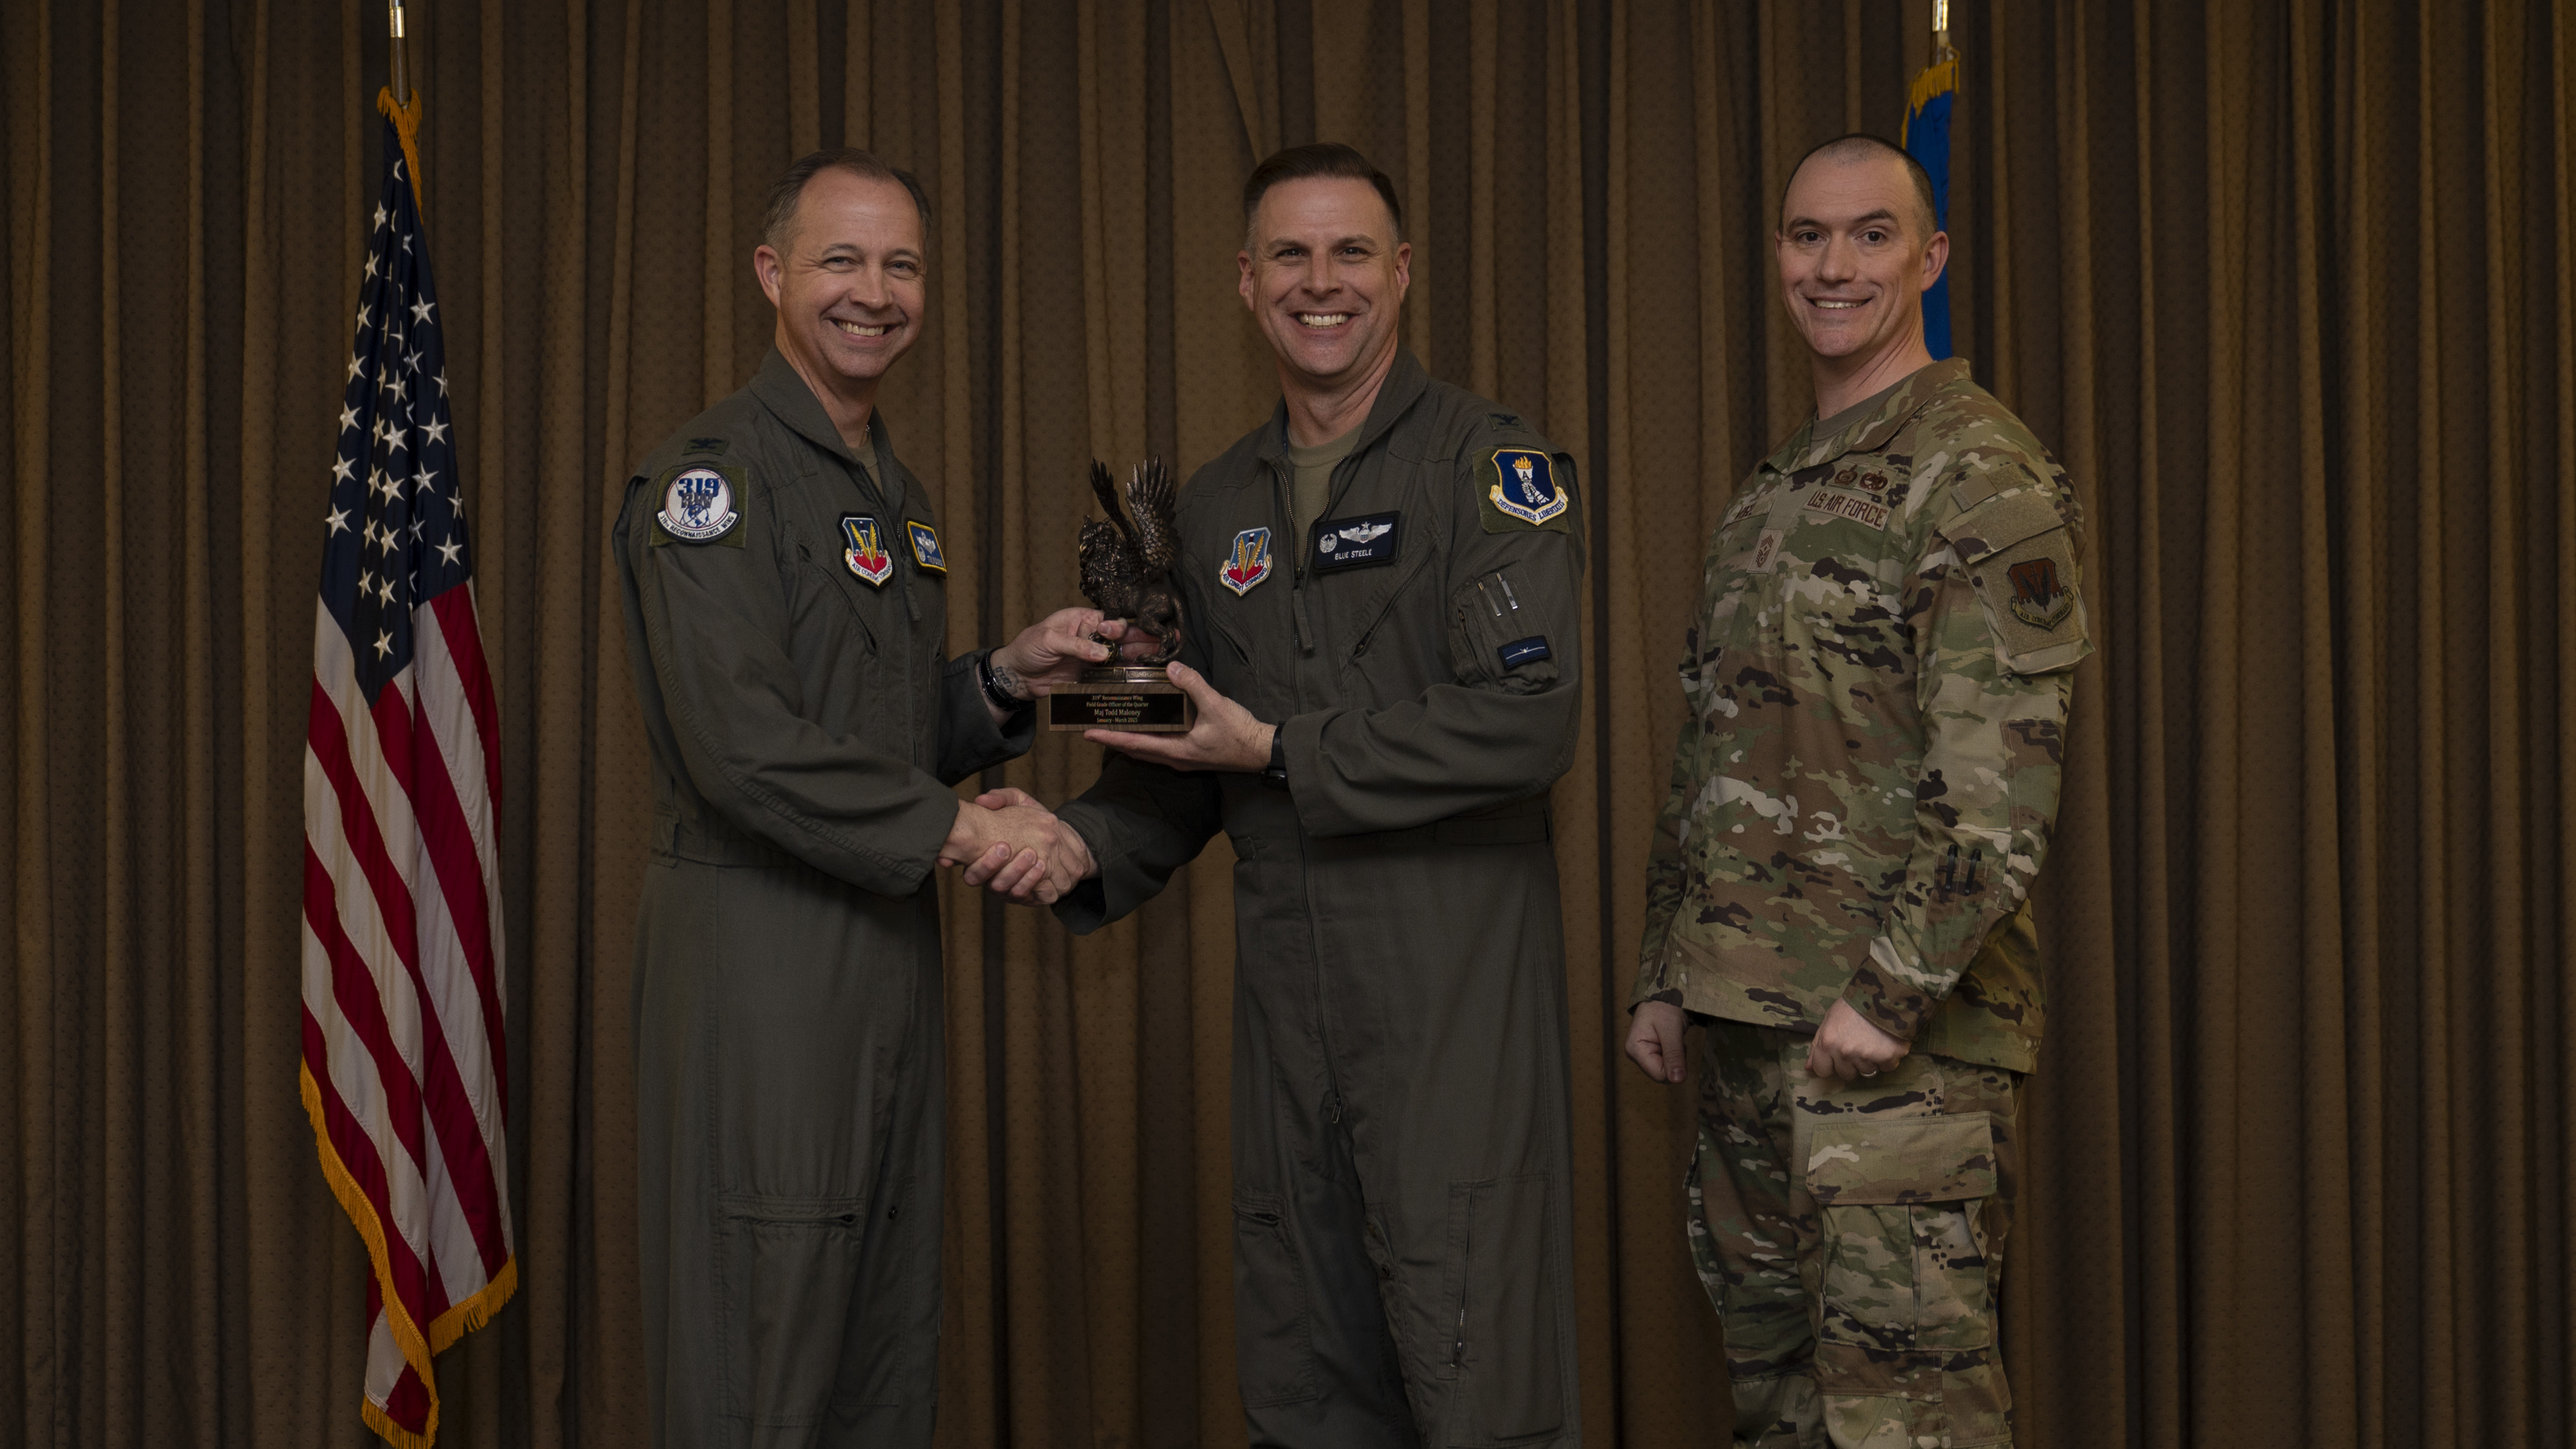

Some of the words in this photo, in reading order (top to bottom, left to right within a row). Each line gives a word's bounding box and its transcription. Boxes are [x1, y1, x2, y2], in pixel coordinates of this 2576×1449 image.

[679, 478, 719, 497] 319
[1496, 499, 1536, 522] DEFENSORES
[1807, 490, 1827, 508] U.S.
[1824, 494, 1845, 514] AIR
[1842, 497, 1887, 527] FORCE
[669, 524, 721, 538] RECONNAISSANCE
[721, 515, 734, 528] WING
[1334, 552, 1349, 560] BLUE
[1351, 548, 1372, 558] STEELE
[852, 563, 860, 572] AIR
[1229, 580, 1244, 591] COMBAT
[1245, 568, 1267, 587] COMMAND
[2019, 611, 2030, 621] AIR
[1094, 709, 1104, 717] Maj
[1119, 709, 1141, 717] Maloney
